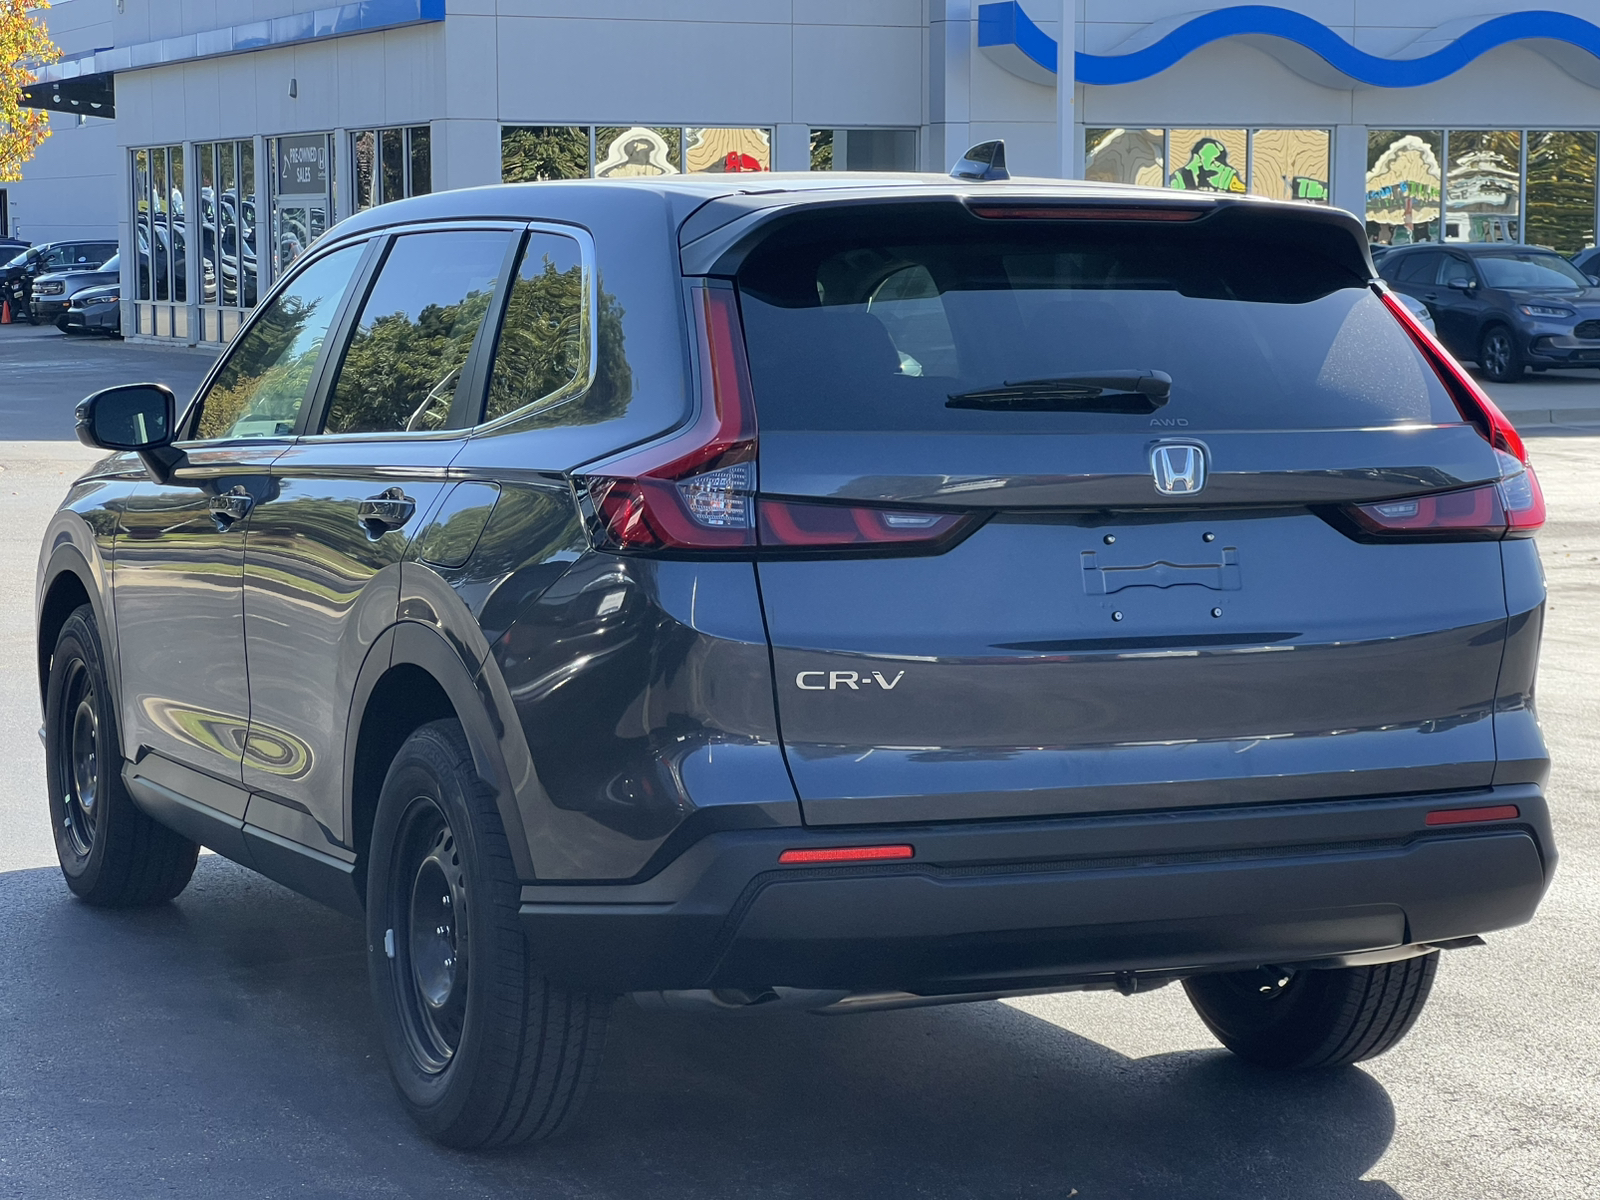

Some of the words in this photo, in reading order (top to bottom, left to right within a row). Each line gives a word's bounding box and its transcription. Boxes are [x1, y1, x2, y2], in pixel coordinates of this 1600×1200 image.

[289, 147, 317, 163] PRE-OWNED
[296, 167, 311, 183] SALES
[1149, 418, 1189, 427] AWD
[795, 670, 905, 691] CR-V
